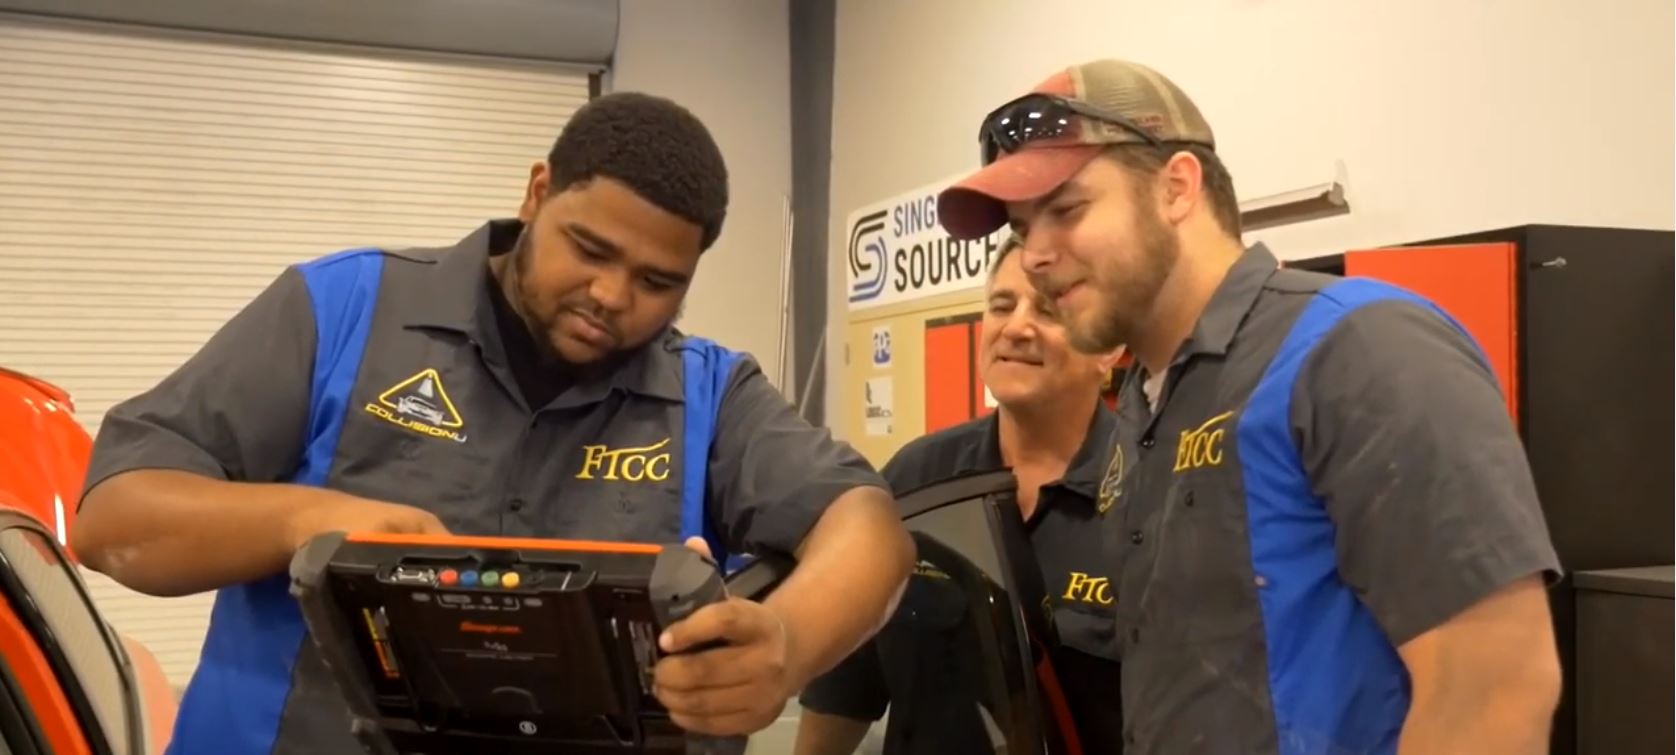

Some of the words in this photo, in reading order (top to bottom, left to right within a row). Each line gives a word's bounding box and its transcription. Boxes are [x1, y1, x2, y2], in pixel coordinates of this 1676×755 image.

[894, 194, 940, 238] SING
[575, 438, 671, 481] FTCC
[1173, 410, 1235, 472] FTCC
[1062, 572, 1114, 604] FTC
